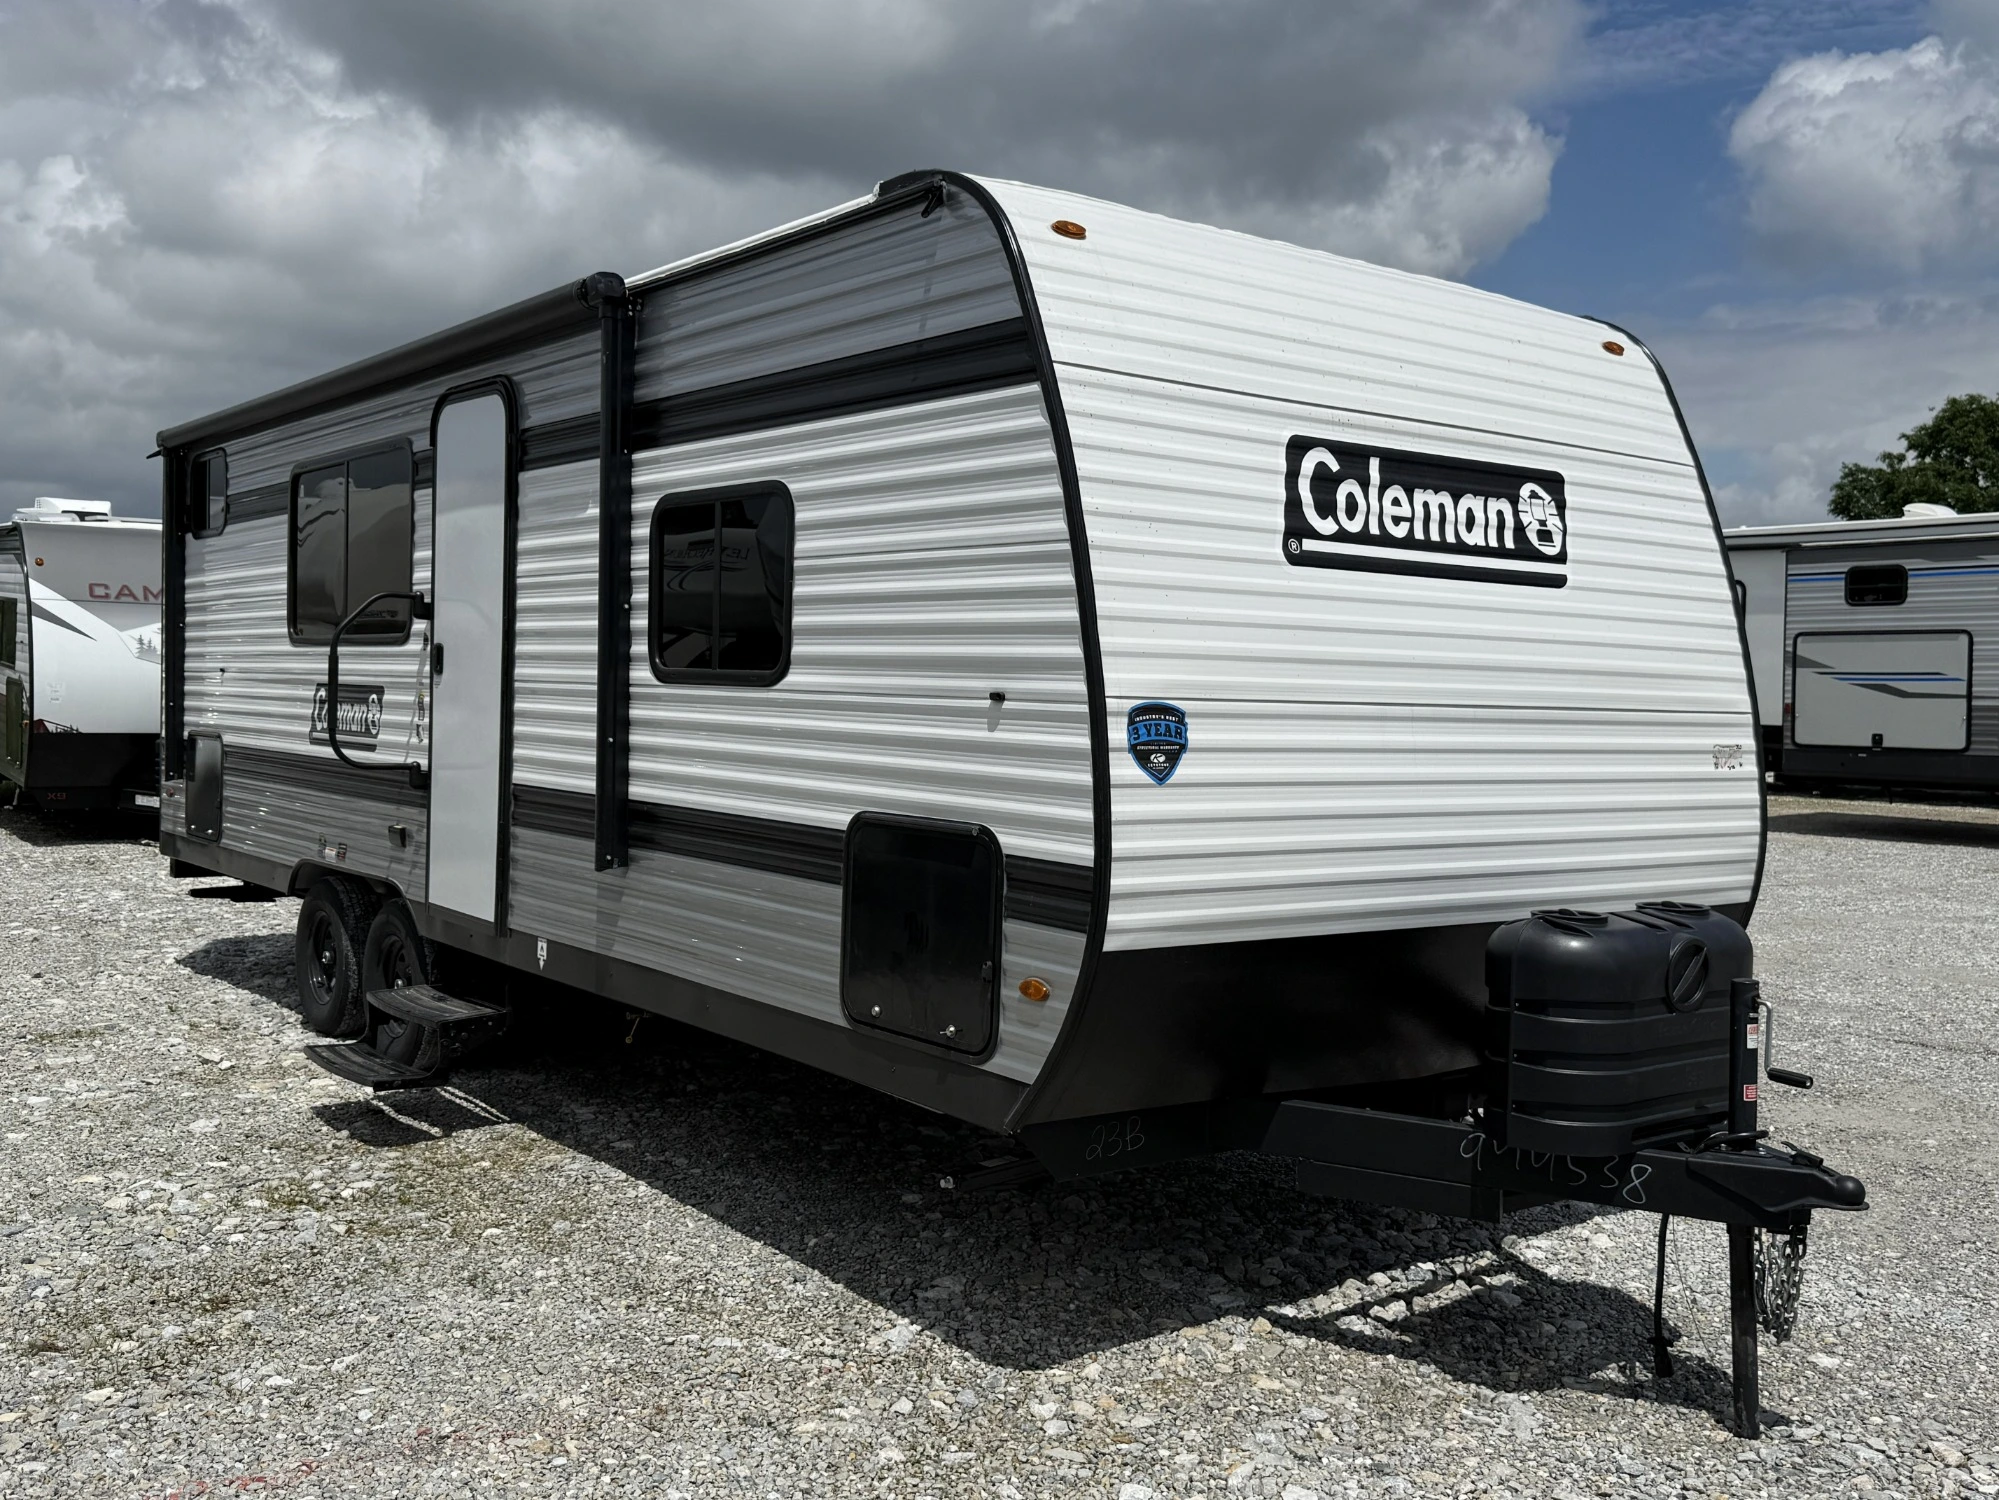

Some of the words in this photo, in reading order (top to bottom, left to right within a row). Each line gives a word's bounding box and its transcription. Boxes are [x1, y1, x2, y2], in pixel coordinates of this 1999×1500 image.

[1298, 447, 1515, 549] Coleman
[1131, 726, 1141, 741] 3
[1142, 722, 1183, 741] YEAR
[1085, 1115, 1145, 1160] 23B
